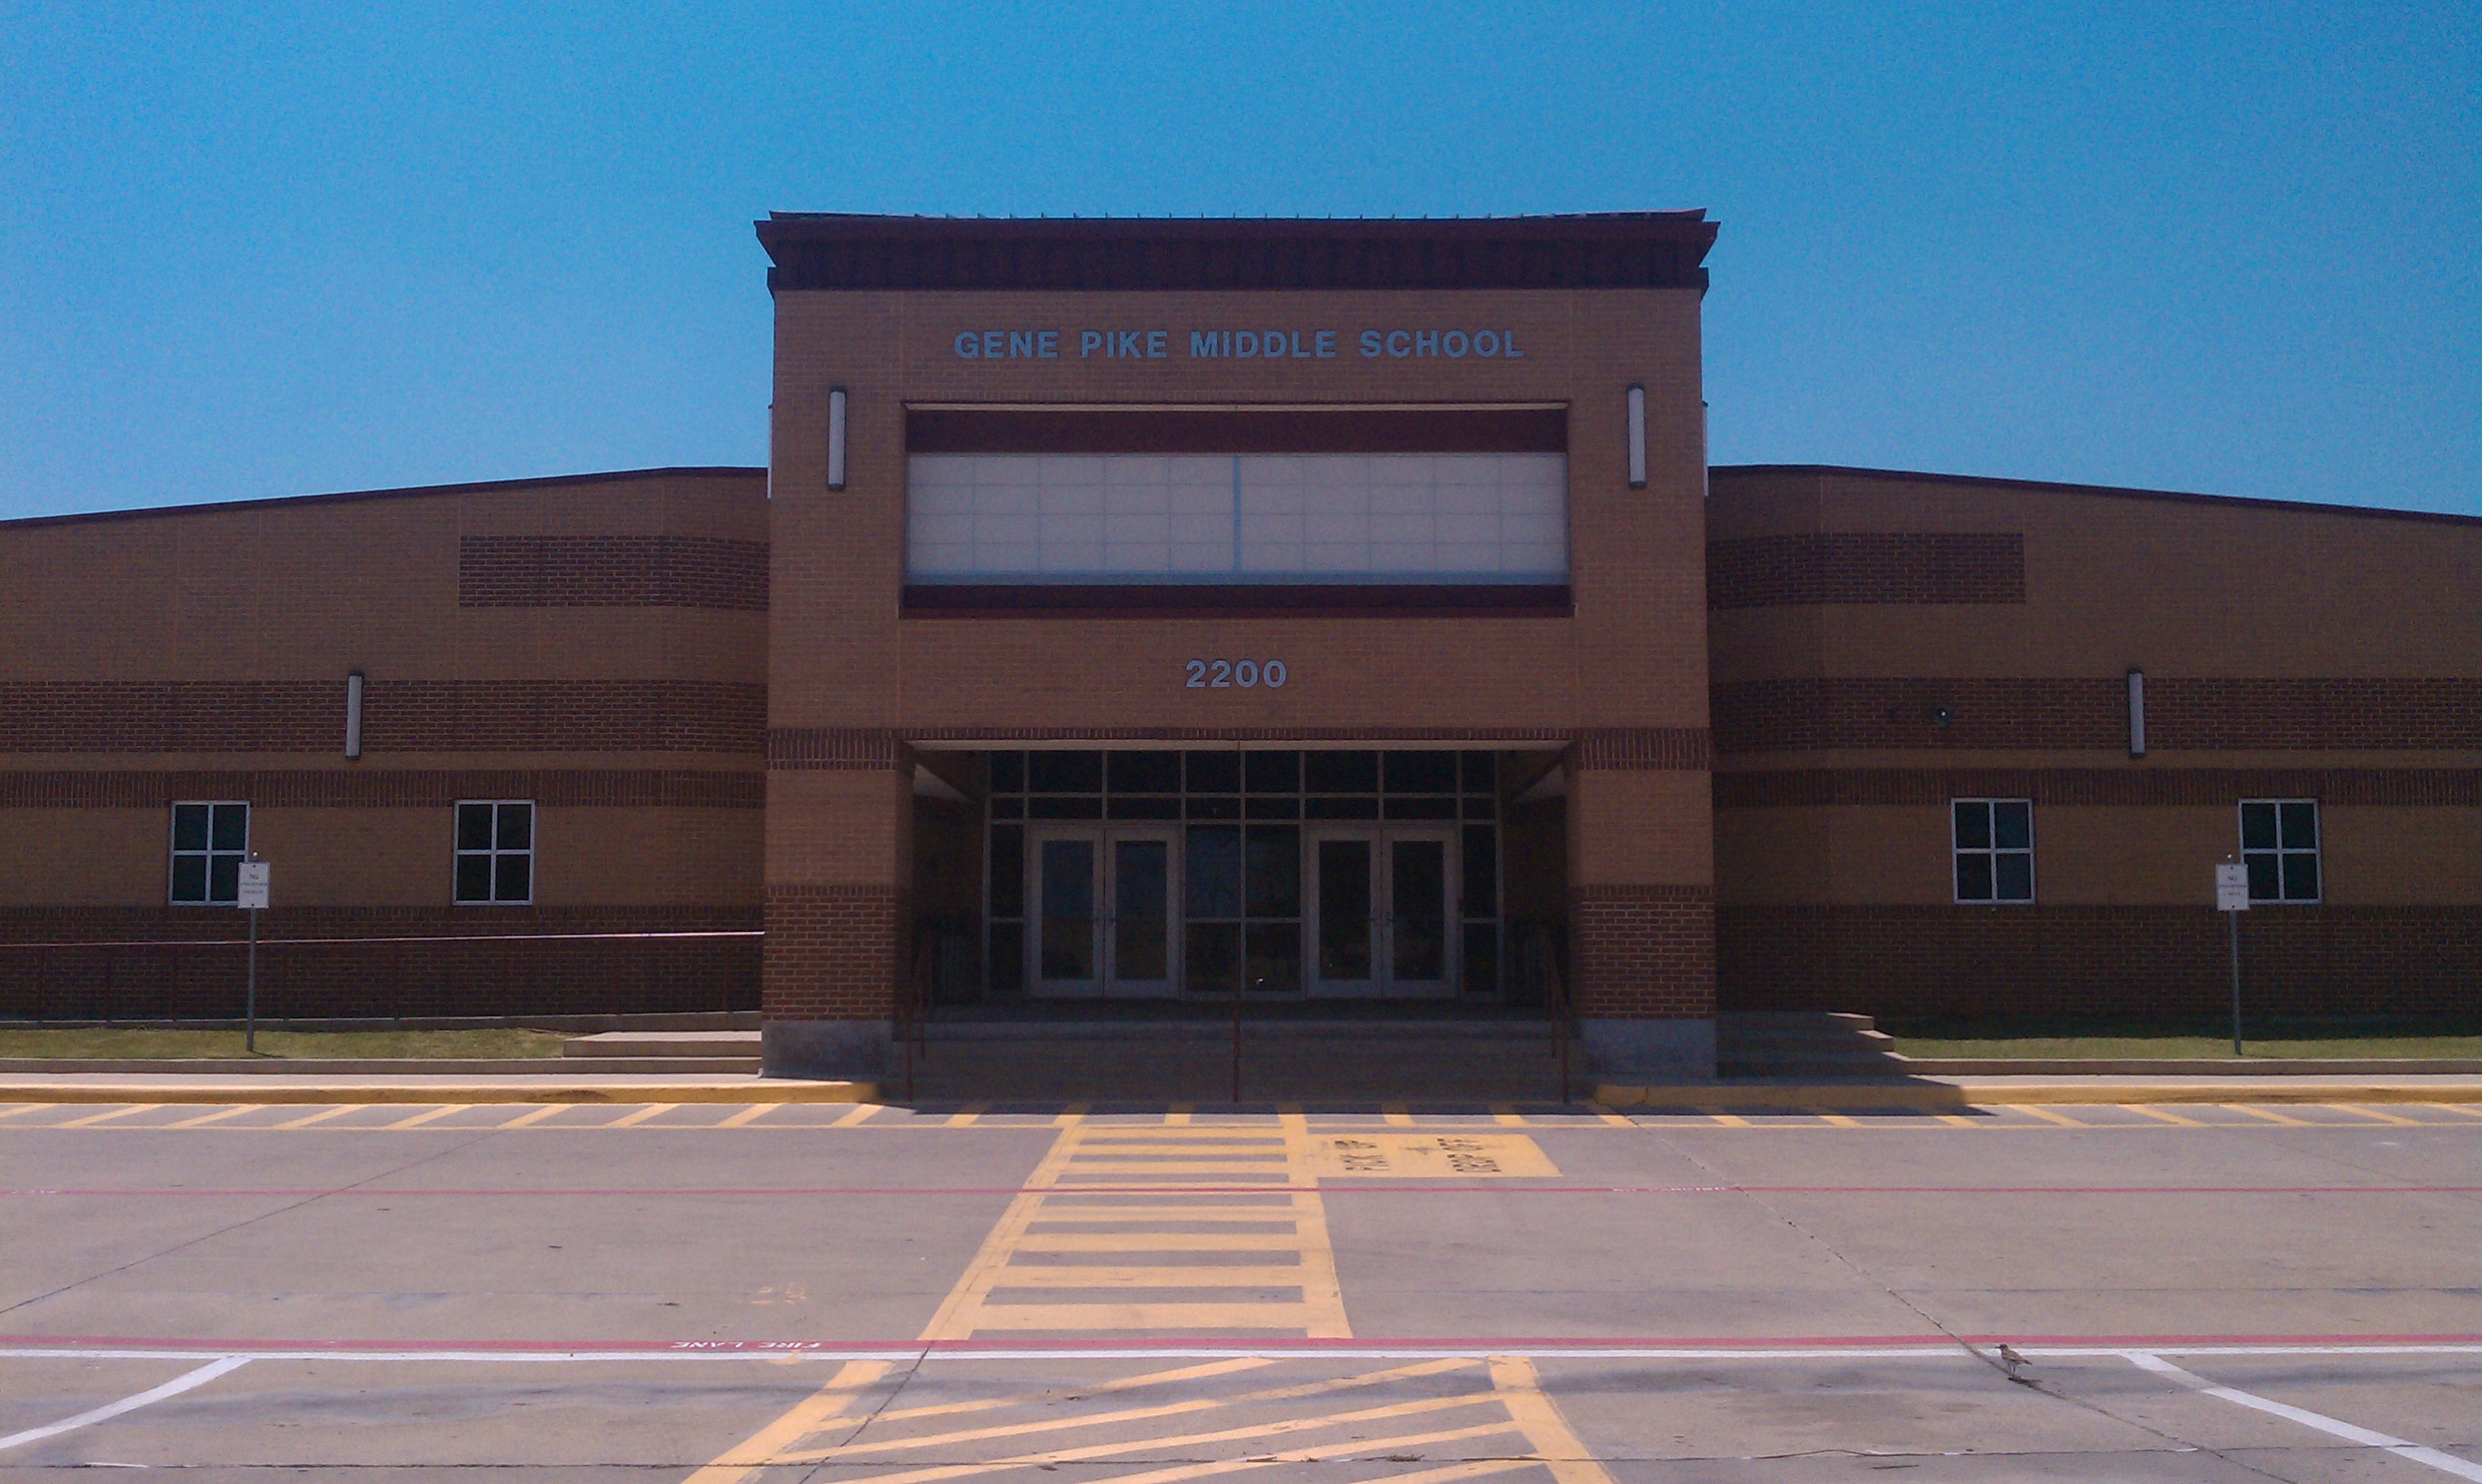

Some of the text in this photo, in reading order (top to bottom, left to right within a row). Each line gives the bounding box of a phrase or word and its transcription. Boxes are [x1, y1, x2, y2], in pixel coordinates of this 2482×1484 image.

[954, 329, 1524, 360] GENE PIKE MIDDLE SCHOOL
[1185, 659, 1287, 688] 2200
[1436, 1138, 1502, 1172] DROP OFF
[758, 1341, 821, 1349] FIRE
